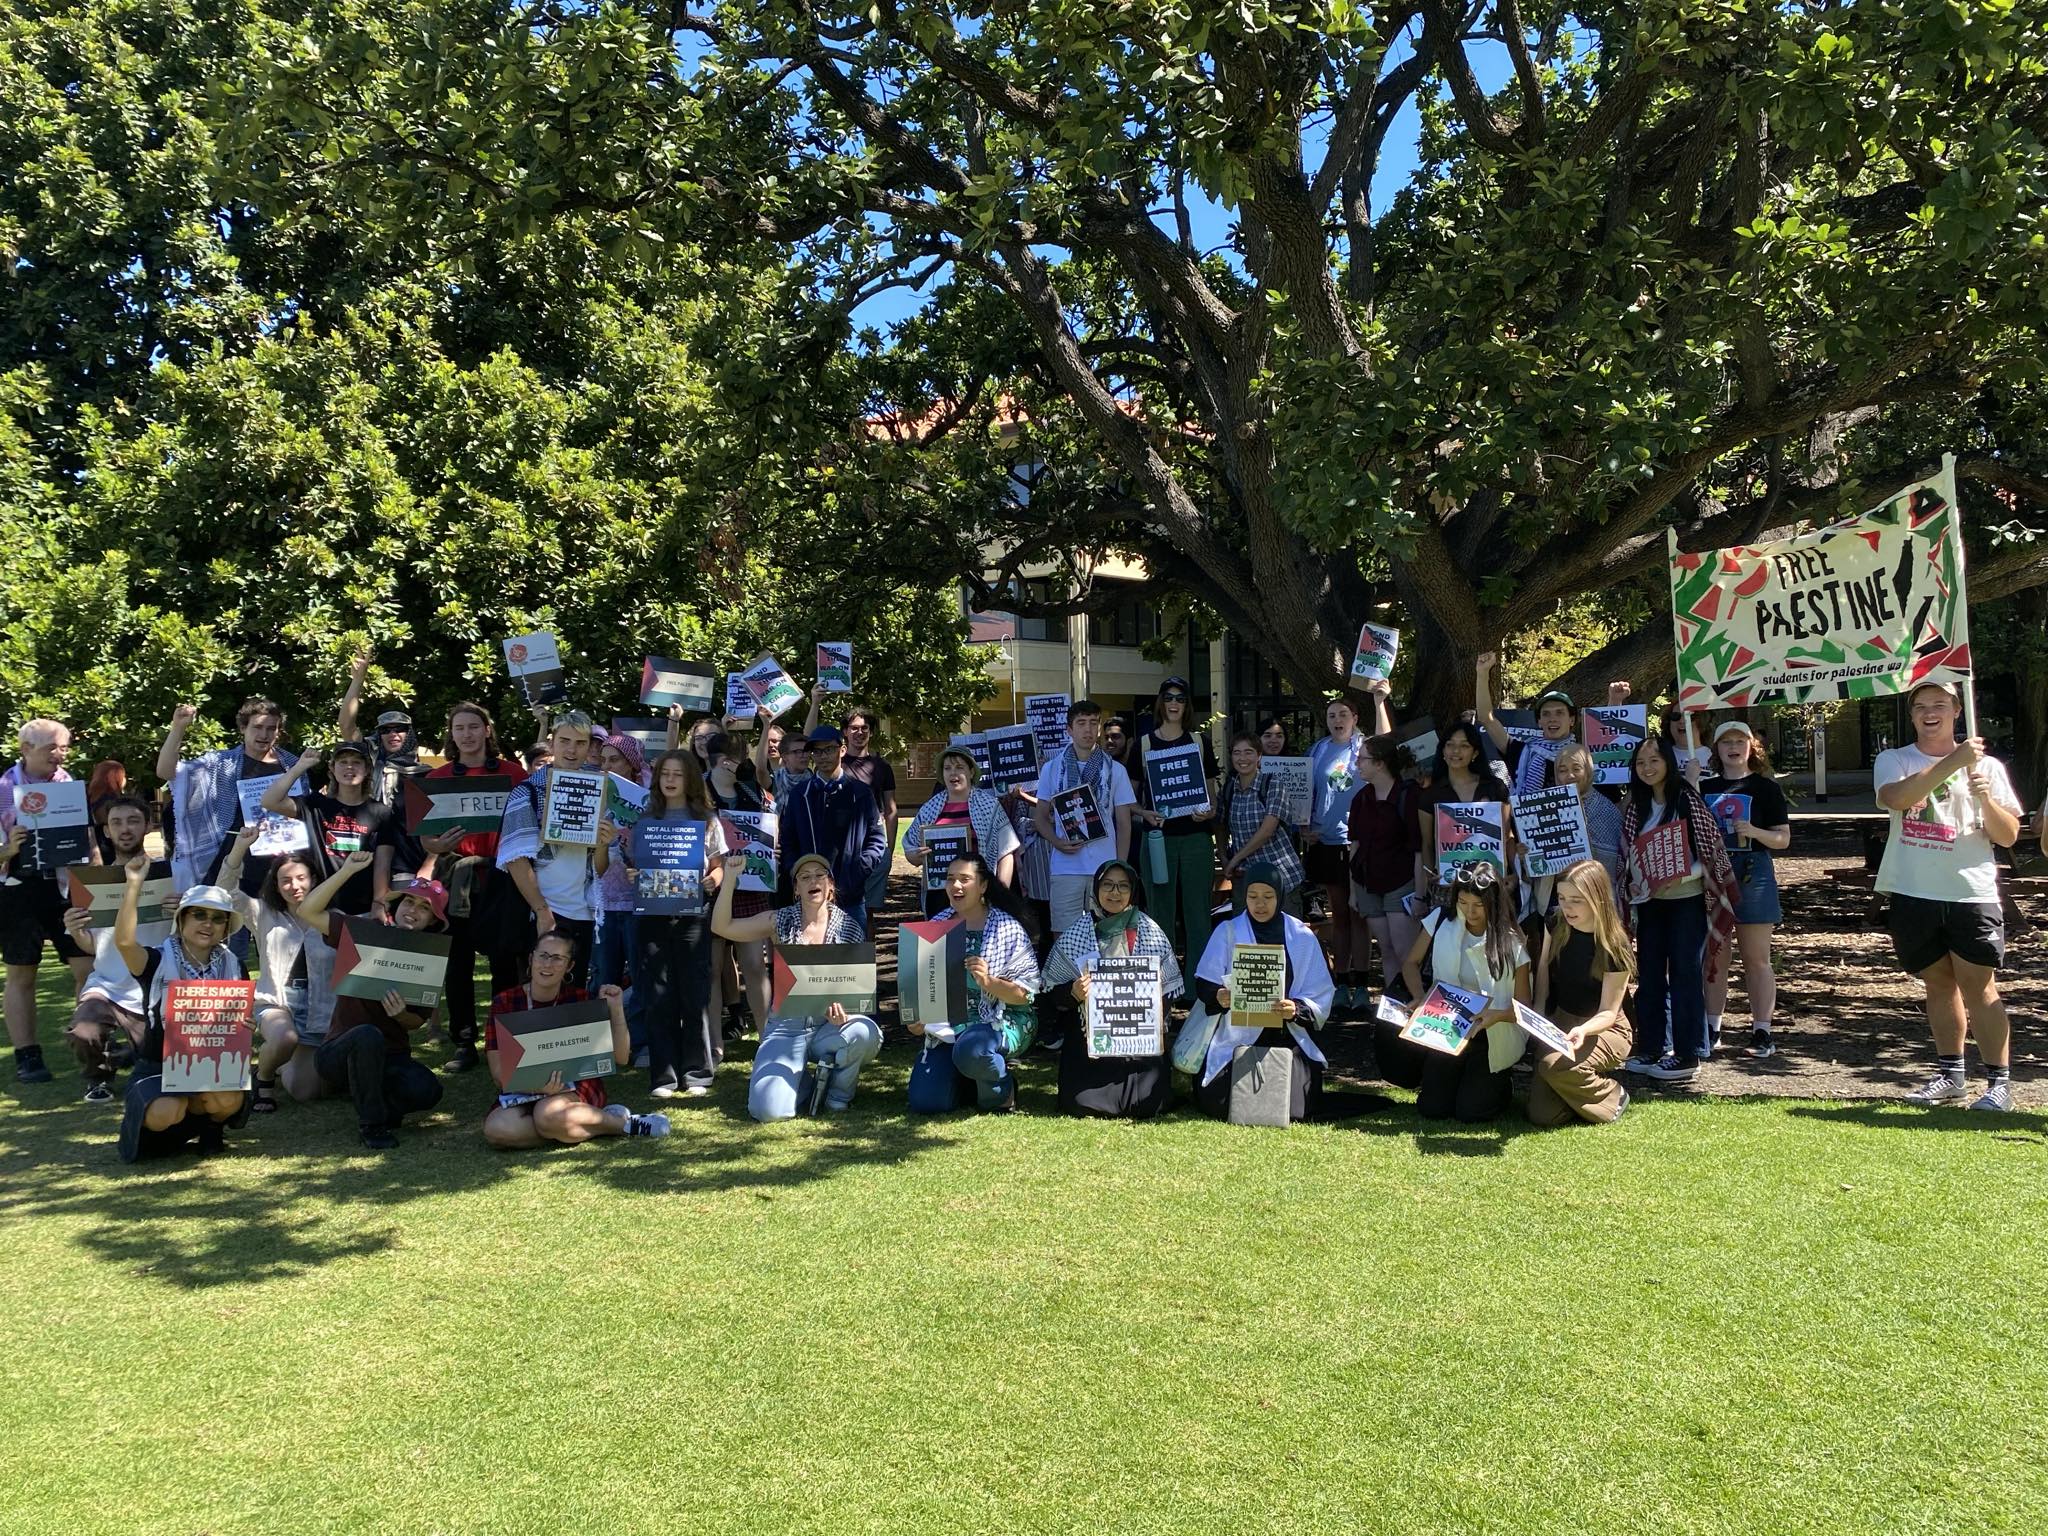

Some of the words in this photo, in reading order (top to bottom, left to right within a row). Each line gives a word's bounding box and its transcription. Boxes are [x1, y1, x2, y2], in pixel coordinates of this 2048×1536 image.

[1772, 546, 1835, 590] FREE
[1755, 567, 1895, 644] PAESTINE
[1381, 653, 1393, 661] ON
[1763, 672, 1809, 685] students
[1810, 669, 1829, 681] for
[1830, 663, 1884, 681] palestine
[775, 678, 787, 687] ON
[1601, 709, 1629, 719] END
[1033, 724, 1067, 732] PALESTINE
[1479, 726, 1545, 738] CEFIRE
[1599, 726, 1627, 736] THE
[998, 740, 1024, 751] FREE
[1589, 743, 1620, 753] WAR
[970, 747, 989, 756] REE
[999, 754, 1025, 765] FREE
[1160, 759, 1189, 772] FREE
[993, 765, 1036, 778] PALESTINE
[560, 777, 580, 785] FROM
[1161, 774, 1191, 787] FREE
[553, 785, 574, 793] RIVER
[1154, 786, 1205, 802] PALESTINE
[1521, 791, 1546, 802] FROM
[1548, 787, 1567, 796] THE
[460, 796, 504, 813] FREE
[555, 804, 594, 813] PALESTINE
[1515, 804, 1542, 815] RIVER
[1543, 801, 1556, 810] TO
[1558, 797, 1577, 806] THE
[1061, 805, 1094, 820] ISRLI
[1455, 807, 1484, 817] END
[735, 815, 761, 825] END
[1540, 813, 1558, 823] SEA
[1453, 824, 1482, 834] THE
[1527, 822, 1577, 837] PALESTINE
[734, 831, 760, 841] THE
[1536, 838, 1559, 847] WILL
[1560, 835, 1573, 843] BE
[934, 842, 958, 850] FREE
[1441, 842, 1474, 851] WAR
[1479, 841, 1500, 851] ON
[755, 849, 773, 860] ON
[1546, 848, 1569, 858] FREE
[1451, 859, 1489, 869] GA
[742, 866, 766, 876] AZA
[373, 958, 390, 968] FREE
[390, 961, 425, 973] PALESTINE
[1099, 958, 1126, 967] FROM
[1129, 958, 1148, 967] THE
[823, 975, 857, 983] PALESTINE
[1090, 972, 1120, 980] RIVER
[1122, 972, 1136, 980] TO
[175, 986, 208, 997] THERE
[208, 987, 219, 997] IS
[219, 987, 249, 997] MORE
[1114, 986, 1133, 994] SEA
[1098, 999, 1151, 1007] PALESTINE
[1447, 992, 1471, 1004] END
[173, 999, 213, 1009] SPILLED
[213, 999, 248, 1010] BLOOD
[1440, 1000, 1463, 1014] THE
[174, 1012, 186, 1022] IN
[186, 1012, 215, 1022] GAZA
[216, 1012, 245, 1022] THAN
[1105, 1013, 1128, 1021] WILL
[1131, 1013, 1144, 1021] BE
[1423, 1009, 1449, 1023] WAR
[1451, 1019, 1469, 1030] ON
[181, 1024, 237, 1034] DRINKABLE
[1112, 1027, 1137, 1035] FREE
[1423, 1022, 1453, 1038] GAZA
[189, 1037, 225, 1047] WATER
[537, 1042, 554, 1051] FREE
[555, 1035, 591, 1049] PALESTINE
